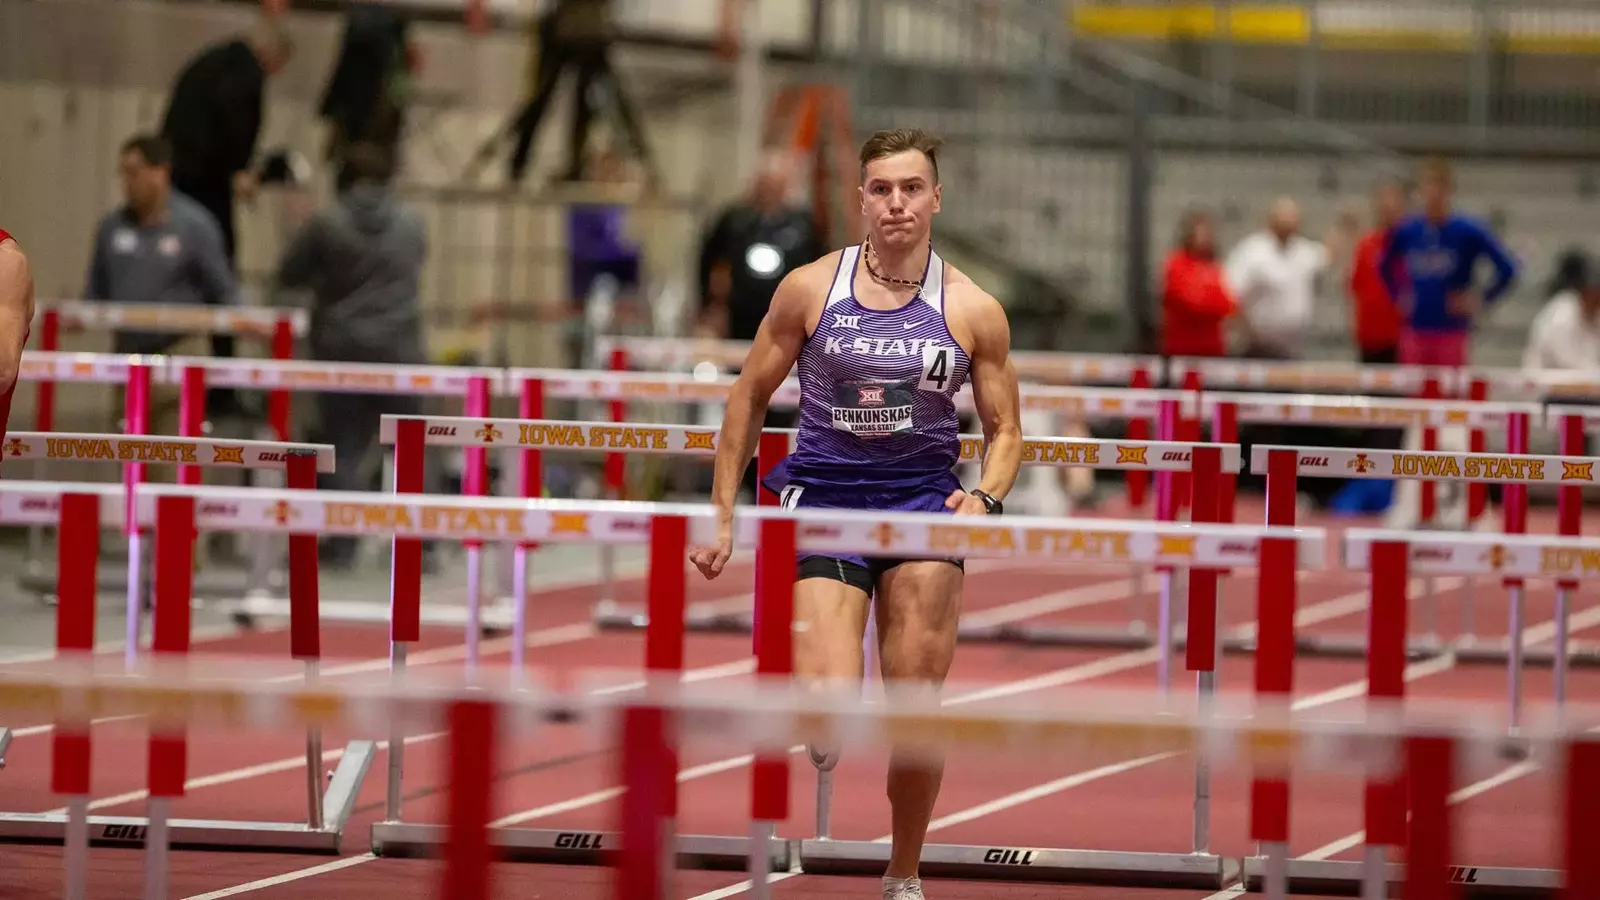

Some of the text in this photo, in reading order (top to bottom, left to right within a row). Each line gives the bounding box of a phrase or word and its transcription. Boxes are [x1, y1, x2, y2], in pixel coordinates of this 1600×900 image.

[831, 313, 862, 330] XII
[926, 349, 948, 389] 4
[834, 406, 911, 423] BENKUNSKAS
[428, 425, 458, 437] GILL
[519, 424, 586, 446] IOWA
[588, 426, 668, 449] STATE
[850, 423, 896, 432] KANSAS STATE
[46, 438, 114, 459] IOWA
[118, 440, 197, 462] STATE
[1022, 441, 1100, 463] STATE
[1161, 451, 1191, 462] GILL
[1300, 456, 1330, 467] GILL
[1392, 454, 1461, 477] IOWA
[1464, 457, 1545, 480] STATE
[554, 833, 603, 849] GILL
[983, 848, 1035, 865] GILL
